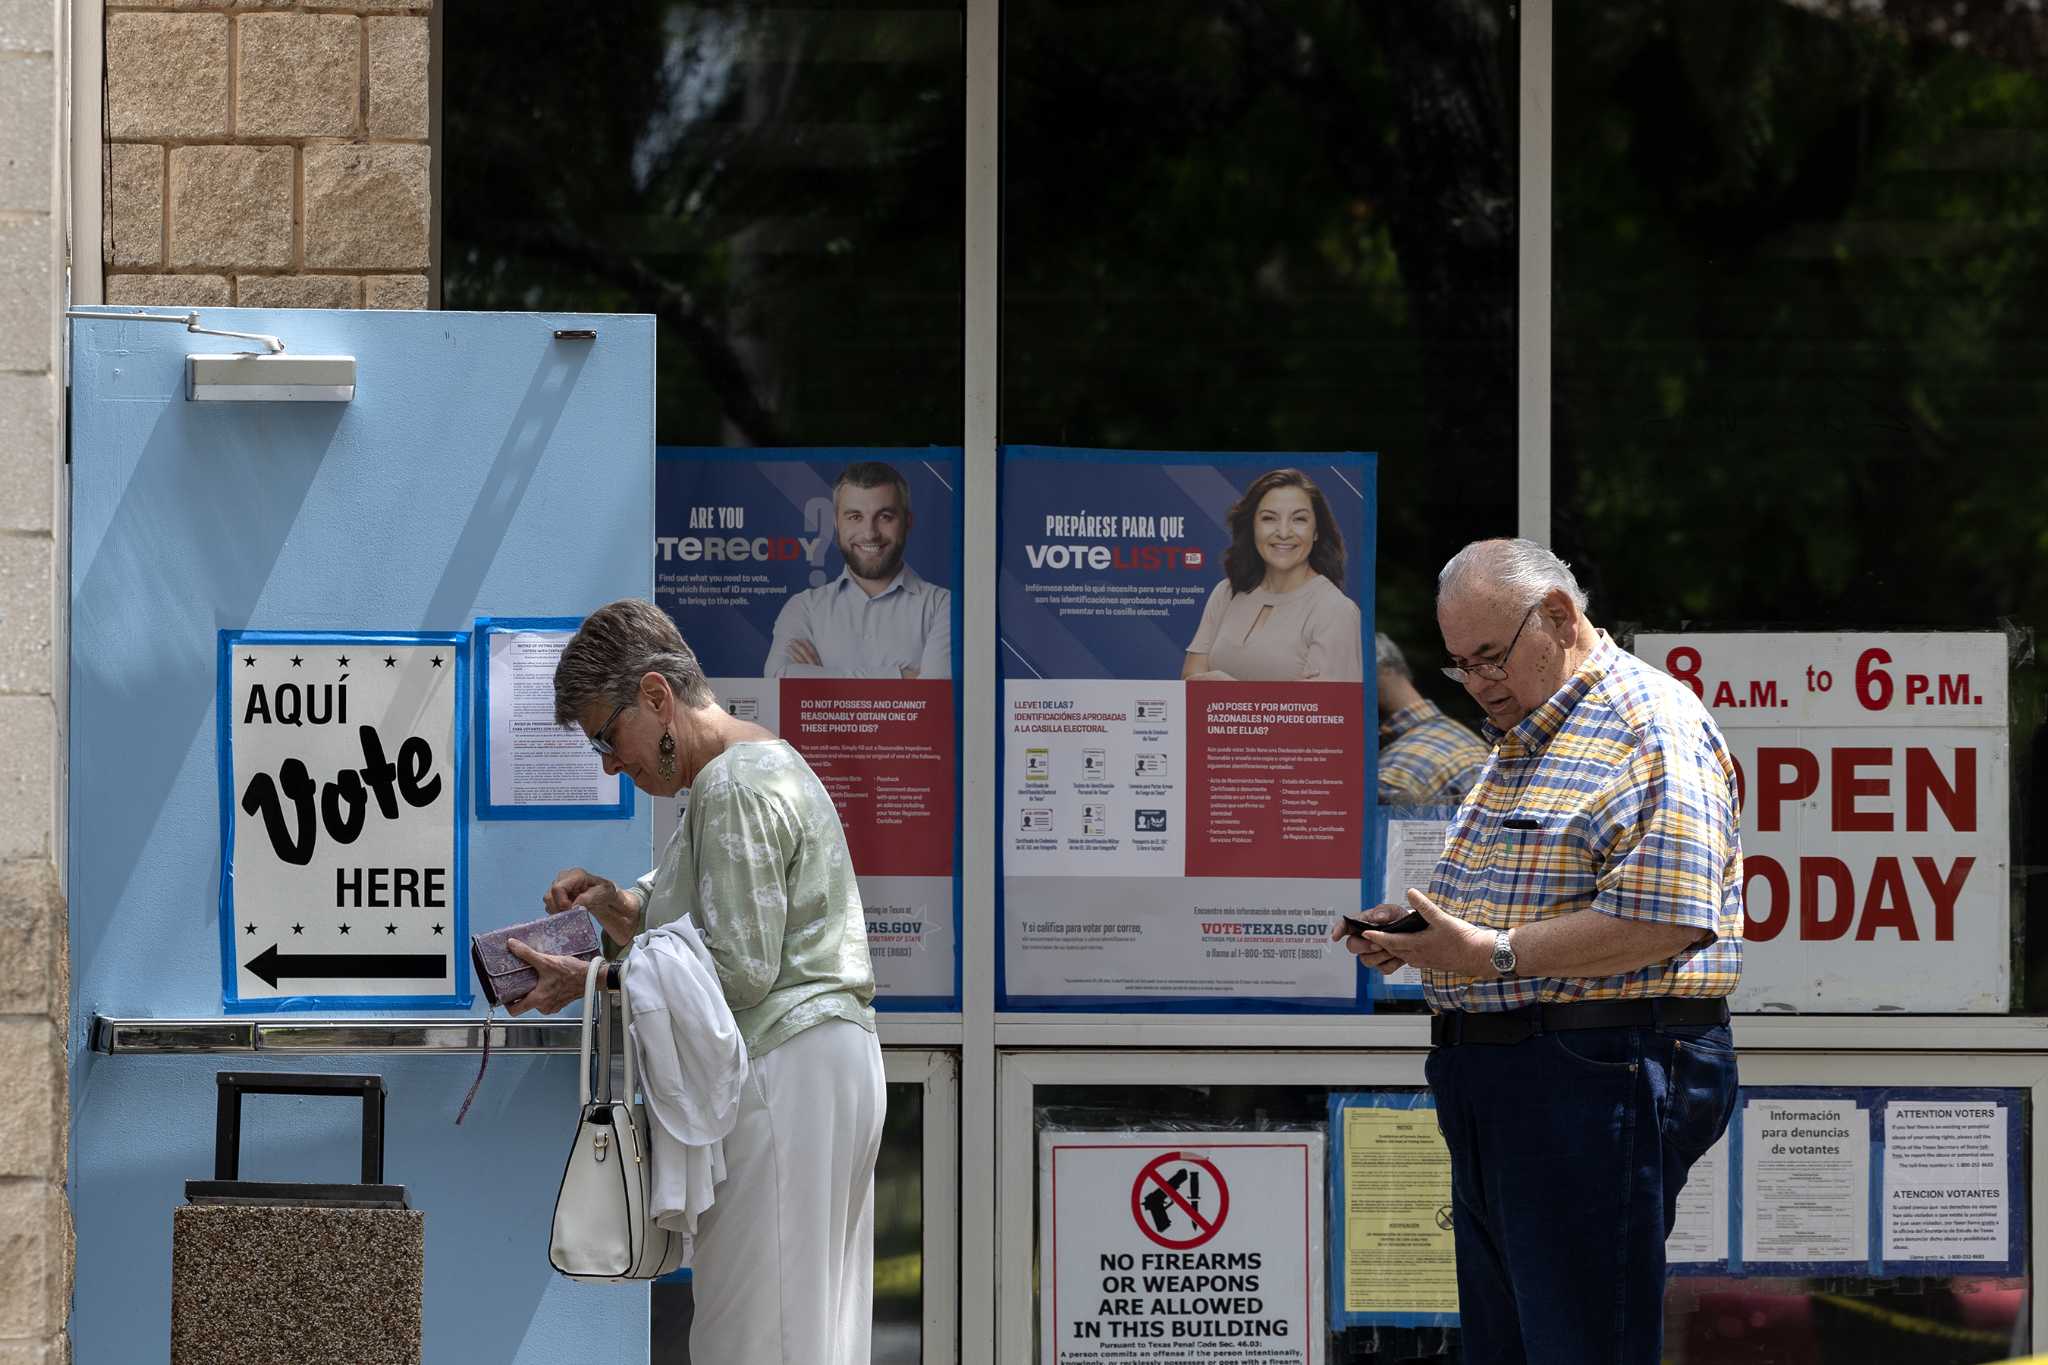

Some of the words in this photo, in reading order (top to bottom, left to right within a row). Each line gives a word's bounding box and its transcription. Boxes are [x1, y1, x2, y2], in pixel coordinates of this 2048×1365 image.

[689, 507, 714, 529] ARE
[718, 507, 744, 529] YOU
[1046, 510, 1117, 538] PREPÁRESE
[1122, 517, 1155, 538] PARA
[1160, 517, 1185, 542] QUE
[1713, 681, 1788, 708] A.M.
[1806, 664, 1833, 692] to
[1855, 647, 1894, 711] 6
[1906, 673, 1983, 705] P.M.
[243, 674, 349, 727] AQUÍ
[801, 700, 813, 709] DO
[815, 700, 833, 709] NOT
[834, 700, 873, 709] POSSESS
[874, 700, 891, 709] AND
[892, 701, 927, 710] CANNOT
[1014, 701, 1037, 709] LLEVE
[1042, 701, 1053, 709] DE
[1054, 701, 1068, 709] LAS
[1069, 701, 1074, 709] 7
[1227, 703, 1253, 712] POSEE
[1254, 703, 1259, 712] Y
[1261, 703, 1278, 712] POR
[1280, 703, 1319, 712] MOTIVOS
[801, 712, 855, 721] REASONABLY
[856, 712, 887, 721] OBTAIN
[888, 712, 906, 721] ONE
[908, 712, 919, 721] OF
[1208, 715, 1261, 723] RAZONABLES
[1263, 715, 1275, 723] NO
[1277, 715, 1304, 724] PUEDE
[1306, 716, 1345, 725] OBTENER
[801, 724, 829, 733] THESE
[830, 724, 858, 733] PHOTO
[1014, 725, 1020, 733] A
[1021, 725, 1031, 733] LA
[1032, 725, 1063, 733] CASILLA
[1208, 726, 1226, 735] UNA
[1227, 726, 1239, 735] DE
[1240, 726, 1269, 735] ELLAS?
[241, 725, 442, 866] Vote
[1728, 747, 1977, 833] PEN
[336, 868, 446, 908] HERE
[1741, 854, 1977, 942] ODAY
[1022, 922, 1027, 933] Y
[1028, 922, 1035, 933] si
[1036, 922, 1064, 933] califica
[1065, 925, 1082, 935] para
[1083, 924, 1102, 933] votar
[1103, 925, 1115, 936] por
[1201, 923, 1329, 936] VOTETEXAS.GOV
[1770, 1111, 1840, 1121] Información
[1896, 1110, 1952, 1118] ATTENTION
[1955, 1109, 1995, 1118] VOTERS
[1762, 1130, 1788, 1140] para
[1791, 1128, 1850, 1138] denuncias
[1771, 1145, 1786, 1154] de
[1790, 1146, 1840, 1155] votantes
[1893, 1190, 1944, 1199] ATENCION
[1947, 1189, 2001, 1198] VOTANTES
[1100, 1253, 1134, 1271] NO
[1142, 1253, 1262, 1271] FIREARMS
[1102, 1275, 1136, 1293] OR
[1142, 1275, 1259, 1293] WEAPONS
[1098, 1298, 1144, 1316] ARE
[1151, 1298, 1264, 1316] ALLOWED
[1074, 1321, 1101, 1338] IN
[1108, 1321, 1165, 1338] THIS
[1172, 1320, 1289, 1337] BUILDING
